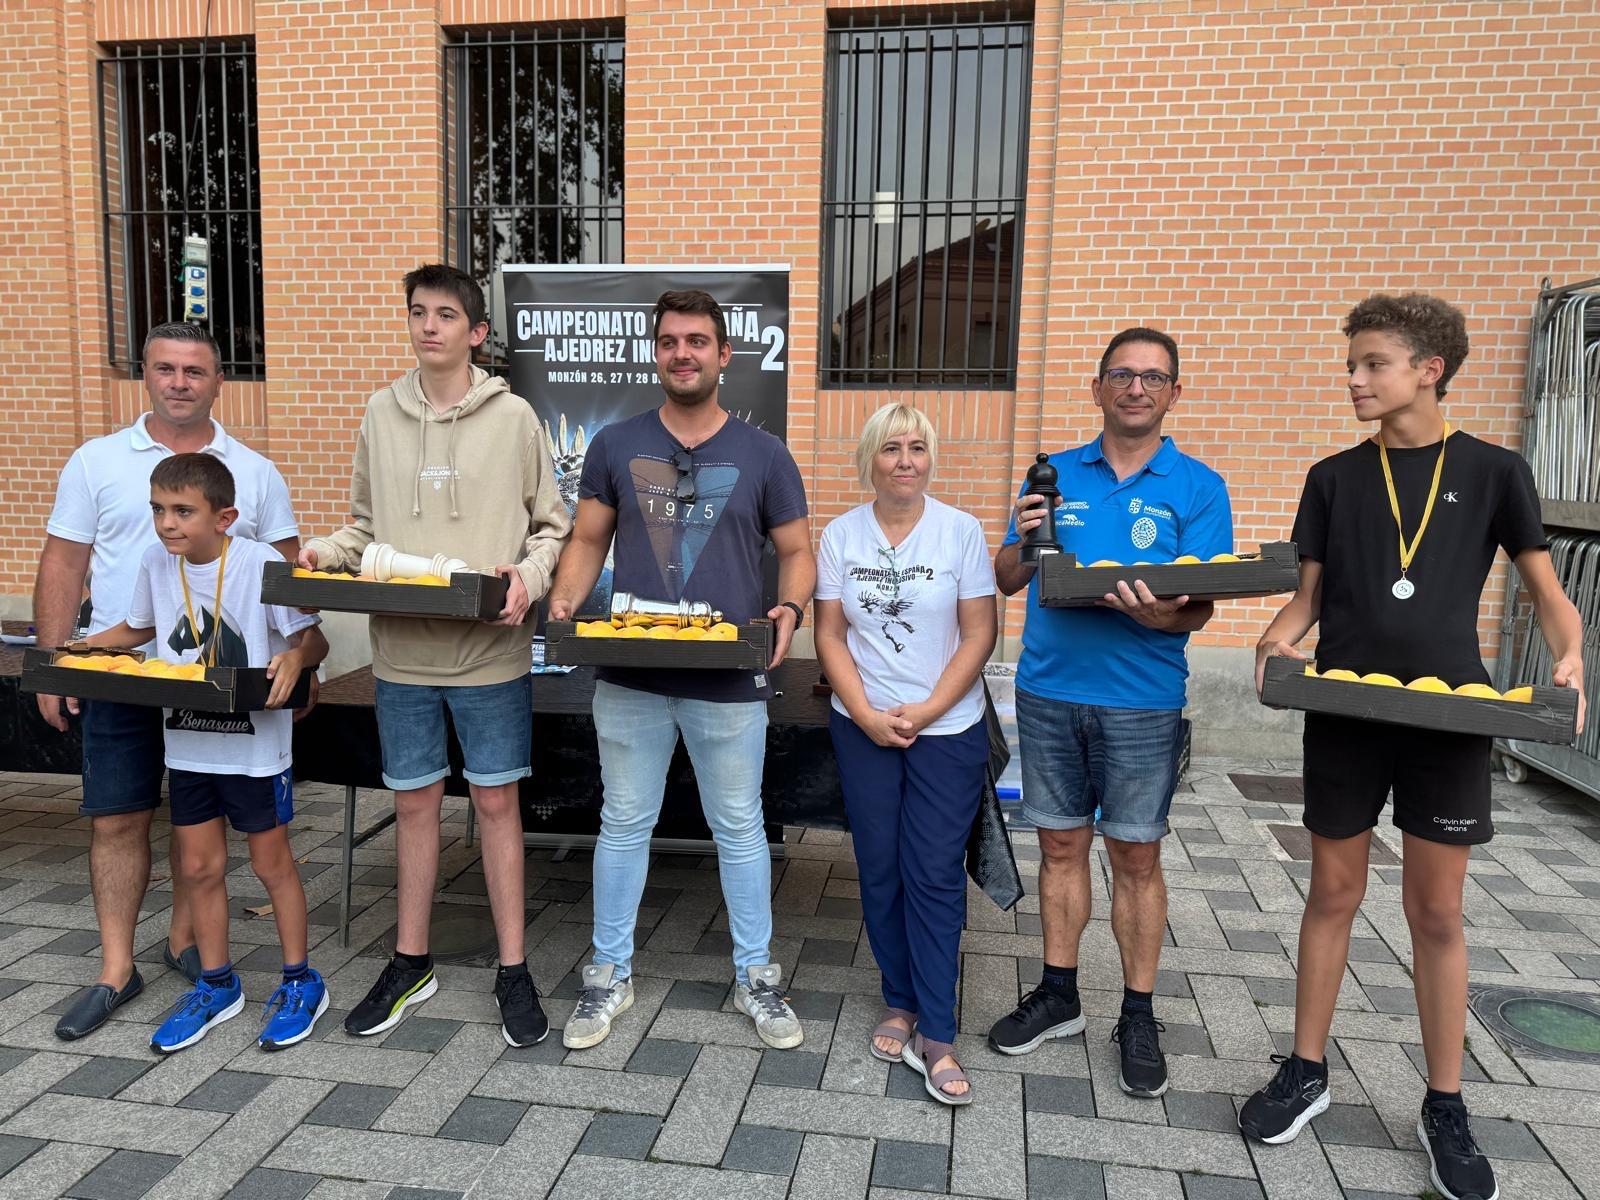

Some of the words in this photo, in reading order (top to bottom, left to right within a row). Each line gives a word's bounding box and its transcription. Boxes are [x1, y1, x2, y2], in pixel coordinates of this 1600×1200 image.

[517, 310, 647, 341] CAMPEONATO
[544, 339, 626, 363] AJEDREZ
[761, 325, 784, 371] 2
[548, 370, 587, 383] MONZÓN
[591, 372, 607, 384] 26,
[610, 373, 623, 383] 27
[626, 373, 632, 383] Y
[636, 373, 648, 384] 28
[1144, 505, 1172, 517] Monzón
[901, 564, 925, 575] ESPAÑA
[925, 568, 934, 581] 2
[177, 709, 250, 732] Benasque
[1433, 816, 1459, 825] Calvin
